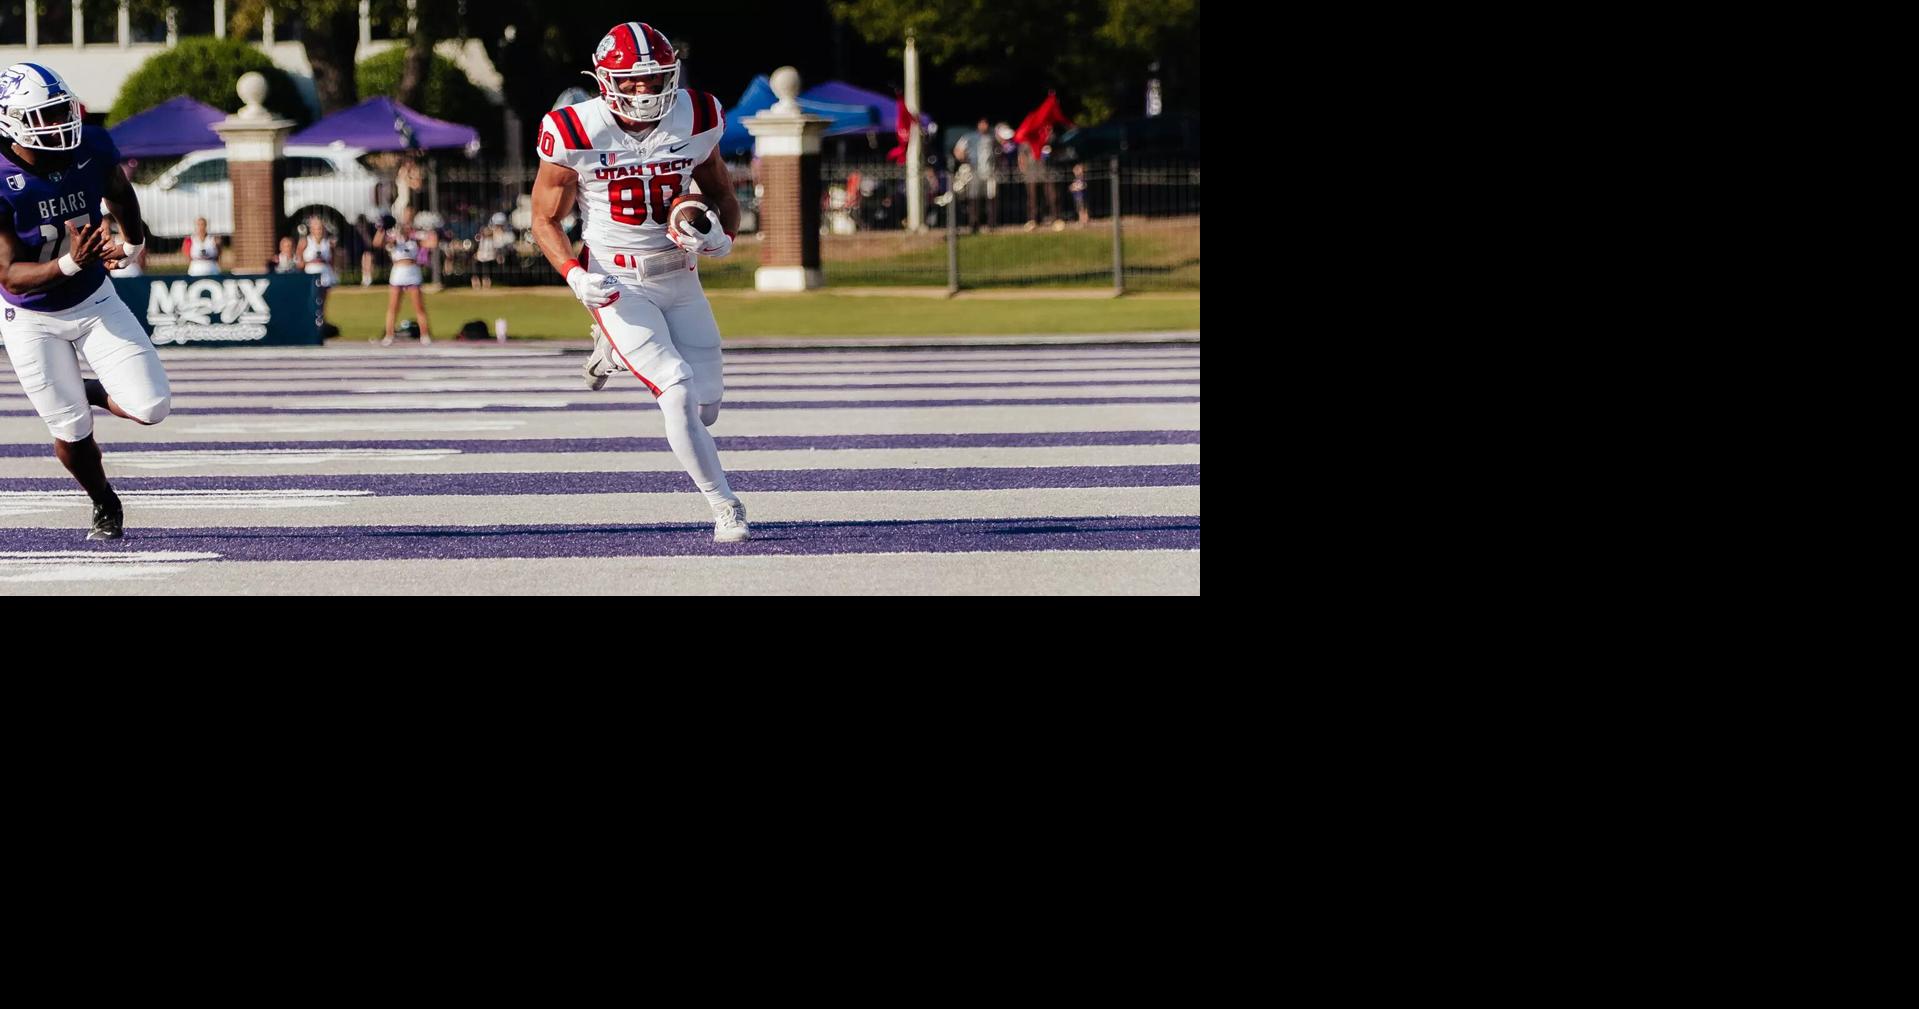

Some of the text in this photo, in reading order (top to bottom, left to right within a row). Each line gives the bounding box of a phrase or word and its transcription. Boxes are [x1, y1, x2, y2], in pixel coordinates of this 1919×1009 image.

[595, 158, 694, 180] UTAH TECH
[38, 191, 87, 219] BEARS
[608, 173, 682, 226] 80
[147, 279, 270, 317] MOIX
